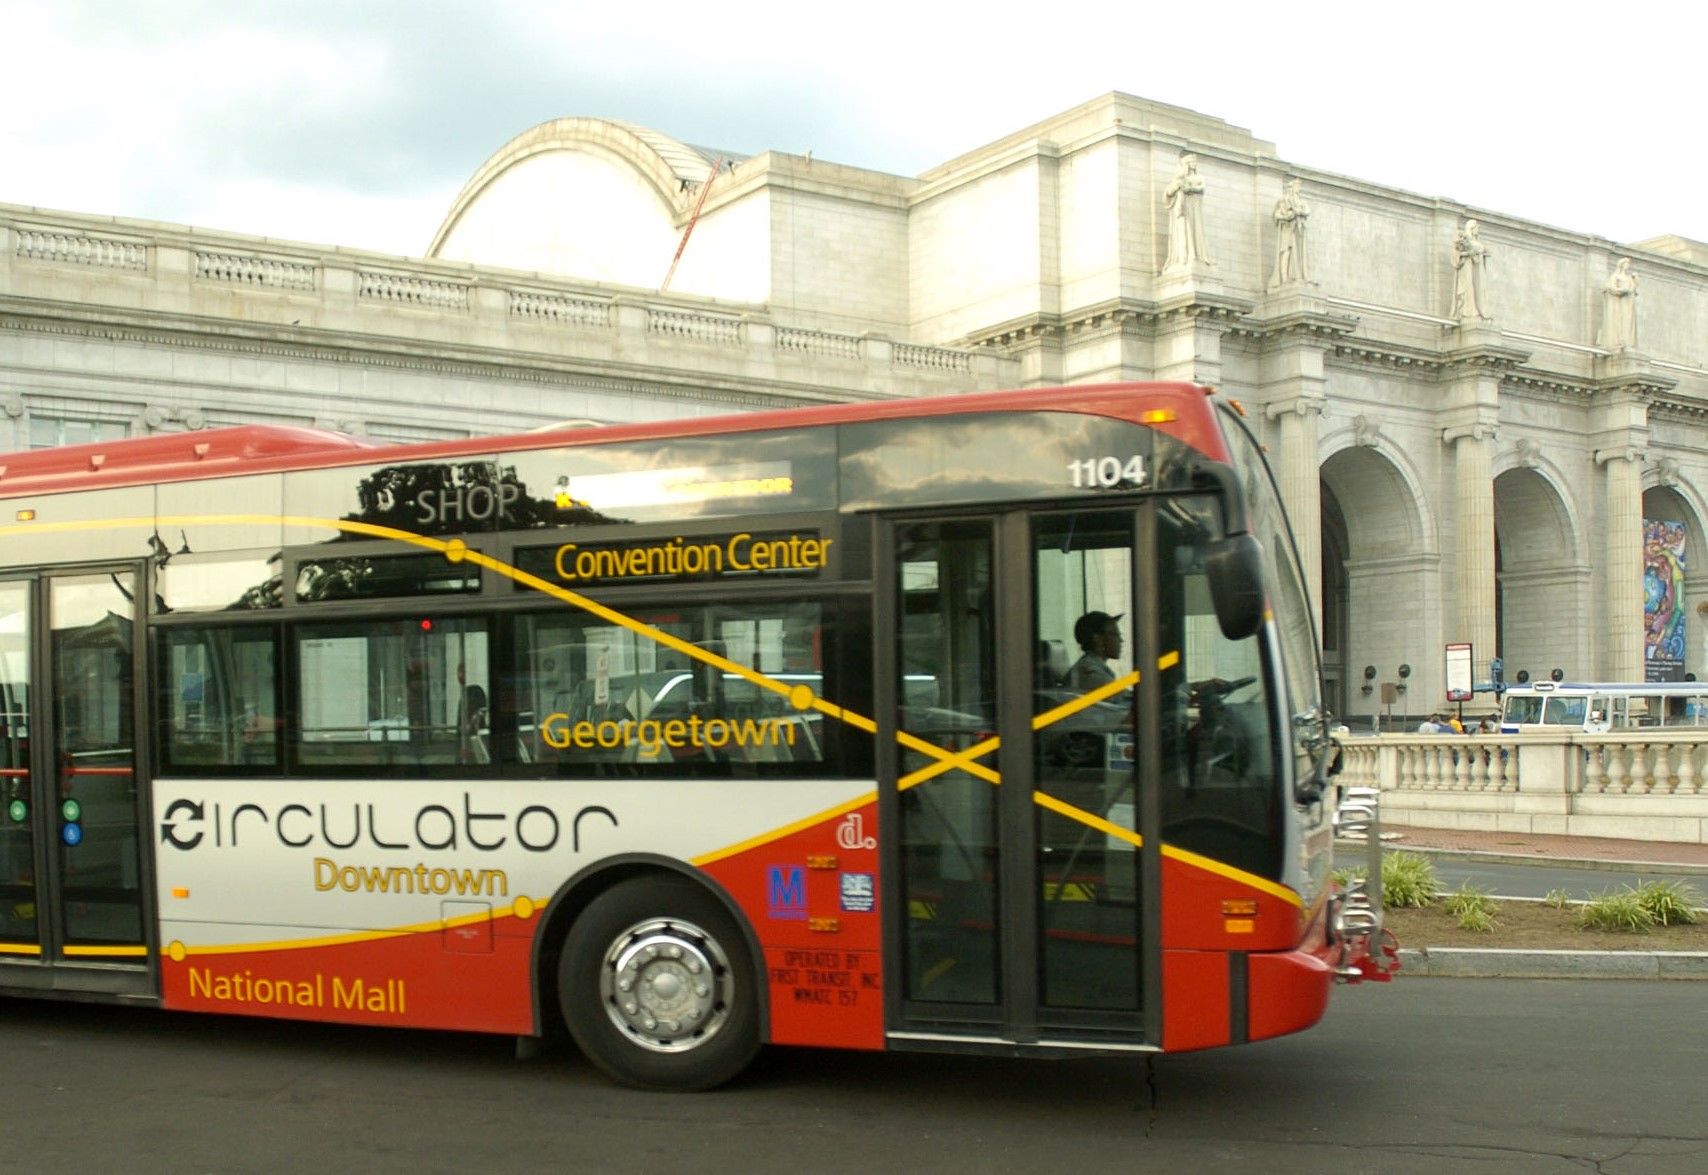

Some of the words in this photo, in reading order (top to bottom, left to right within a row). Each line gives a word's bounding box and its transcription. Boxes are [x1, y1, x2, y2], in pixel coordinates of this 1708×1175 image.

[1067, 455, 1147, 488] 1104
[417, 483, 519, 525] SHOP
[555, 536, 722, 581] Convention
[728, 533, 833, 571] Center
[541, 712, 795, 758] Georgetown
[313, 857, 508, 896] Downtown
[187, 967, 324, 1008] National
[332, 976, 406, 1014] Mall
